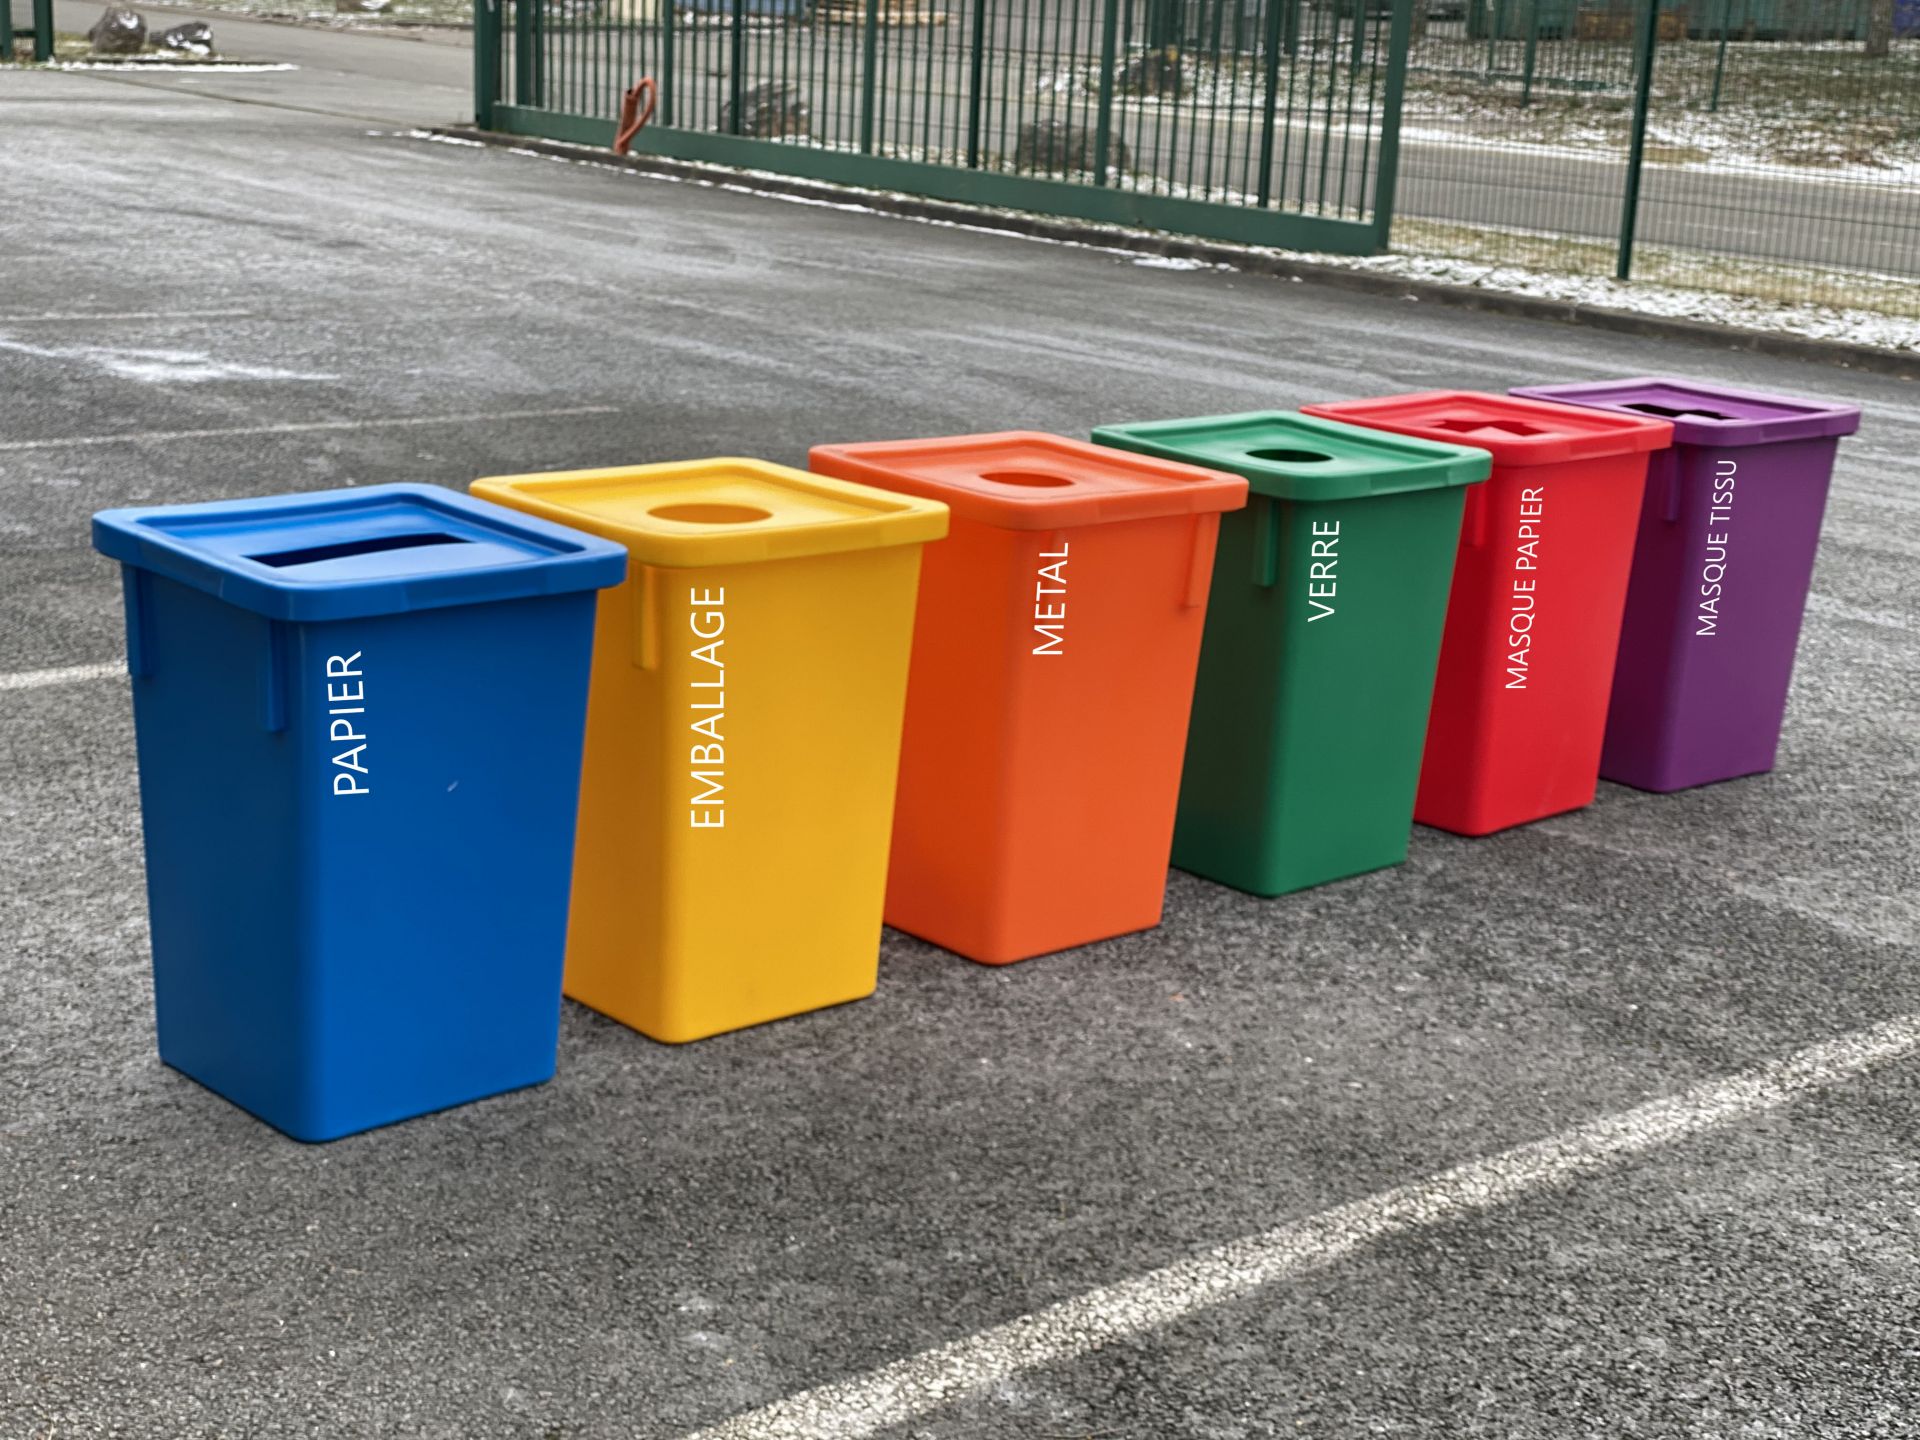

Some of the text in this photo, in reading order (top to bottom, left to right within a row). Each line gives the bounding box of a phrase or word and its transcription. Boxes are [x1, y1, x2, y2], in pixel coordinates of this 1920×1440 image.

[1032, 542, 1069, 656] METAL
[1307, 520, 1340, 623] VERRE
[1505, 486, 1544, 689] MASQUE PAPIER
[1695, 460, 1737, 636] MASQUE TISSU
[326, 650, 370, 796] PAPIER
[689, 587, 725, 829] EMBALLAGE
